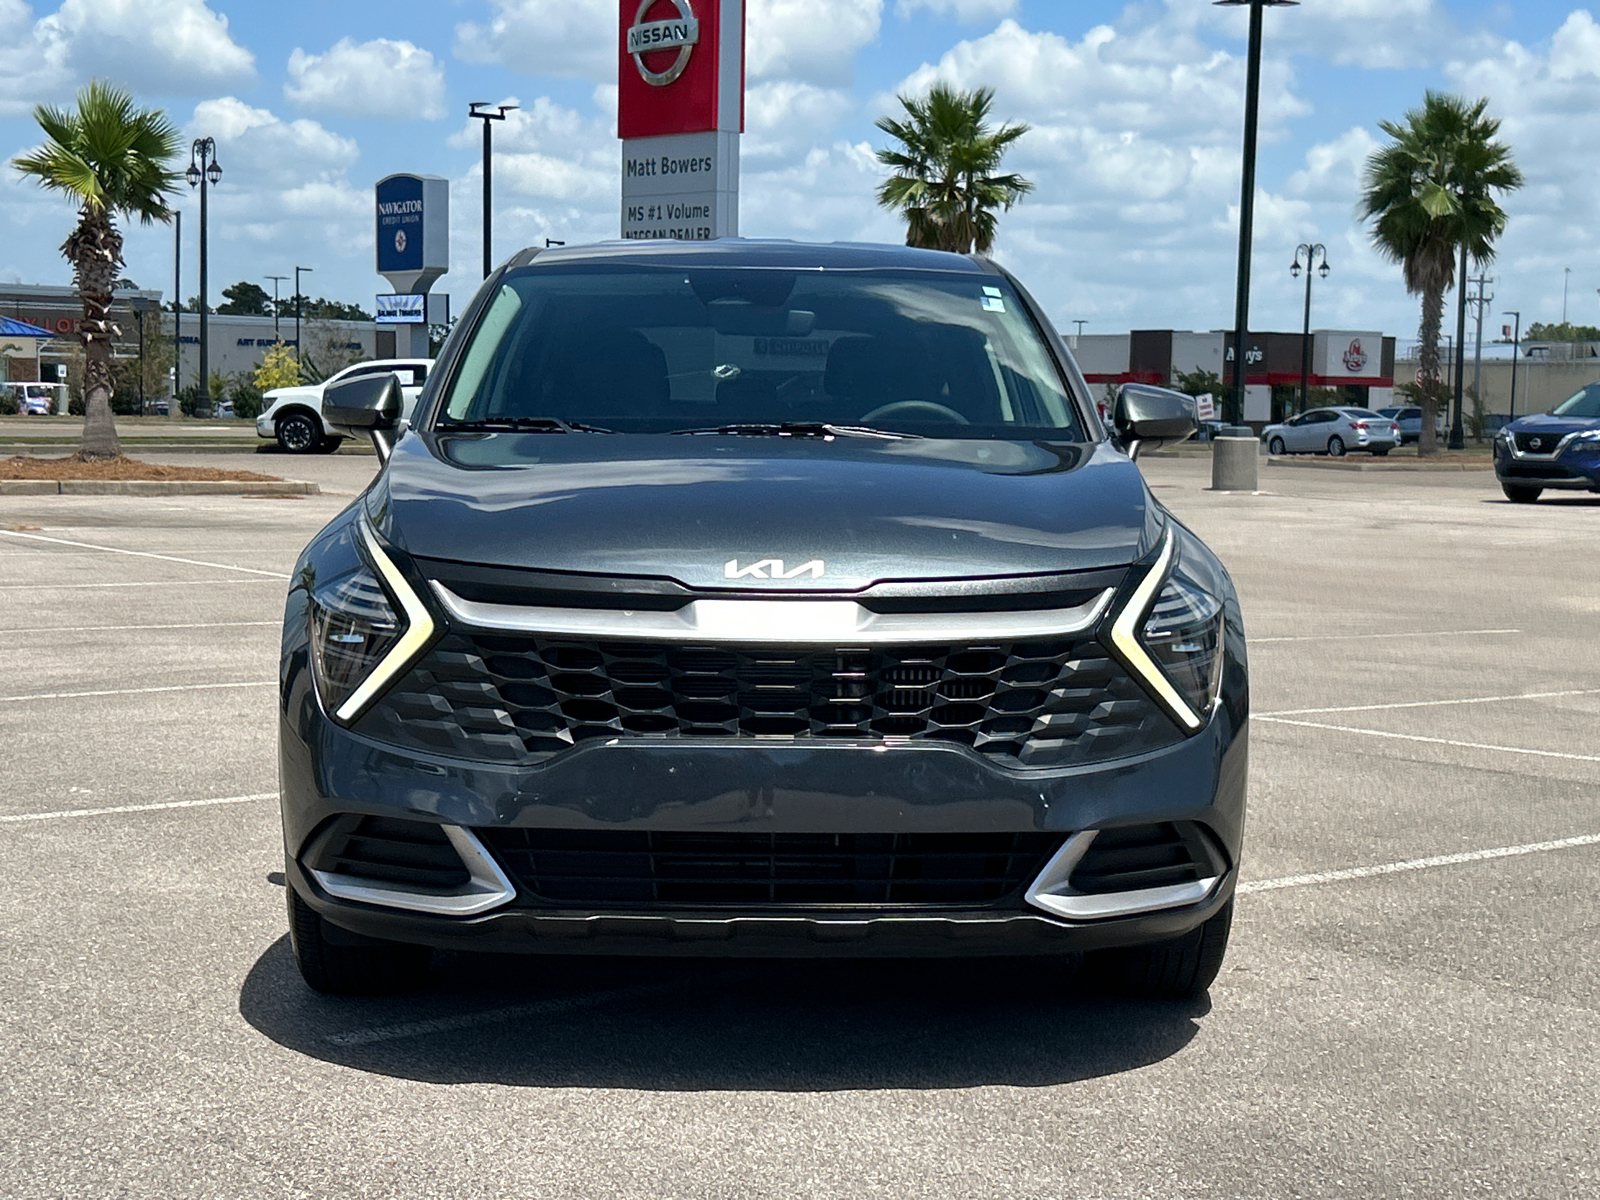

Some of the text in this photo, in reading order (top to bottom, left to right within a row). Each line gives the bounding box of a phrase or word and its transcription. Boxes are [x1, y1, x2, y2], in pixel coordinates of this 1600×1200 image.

[631, 24, 688, 46] NISSAN
[627, 156, 712, 178] Matt Bowers
[378, 200, 423, 216] NAVIGATOR
[628, 203, 710, 222] MS #1 Volume
[1225, 346, 1263, 365] Ay's
[724, 558, 825, 580] KIA
